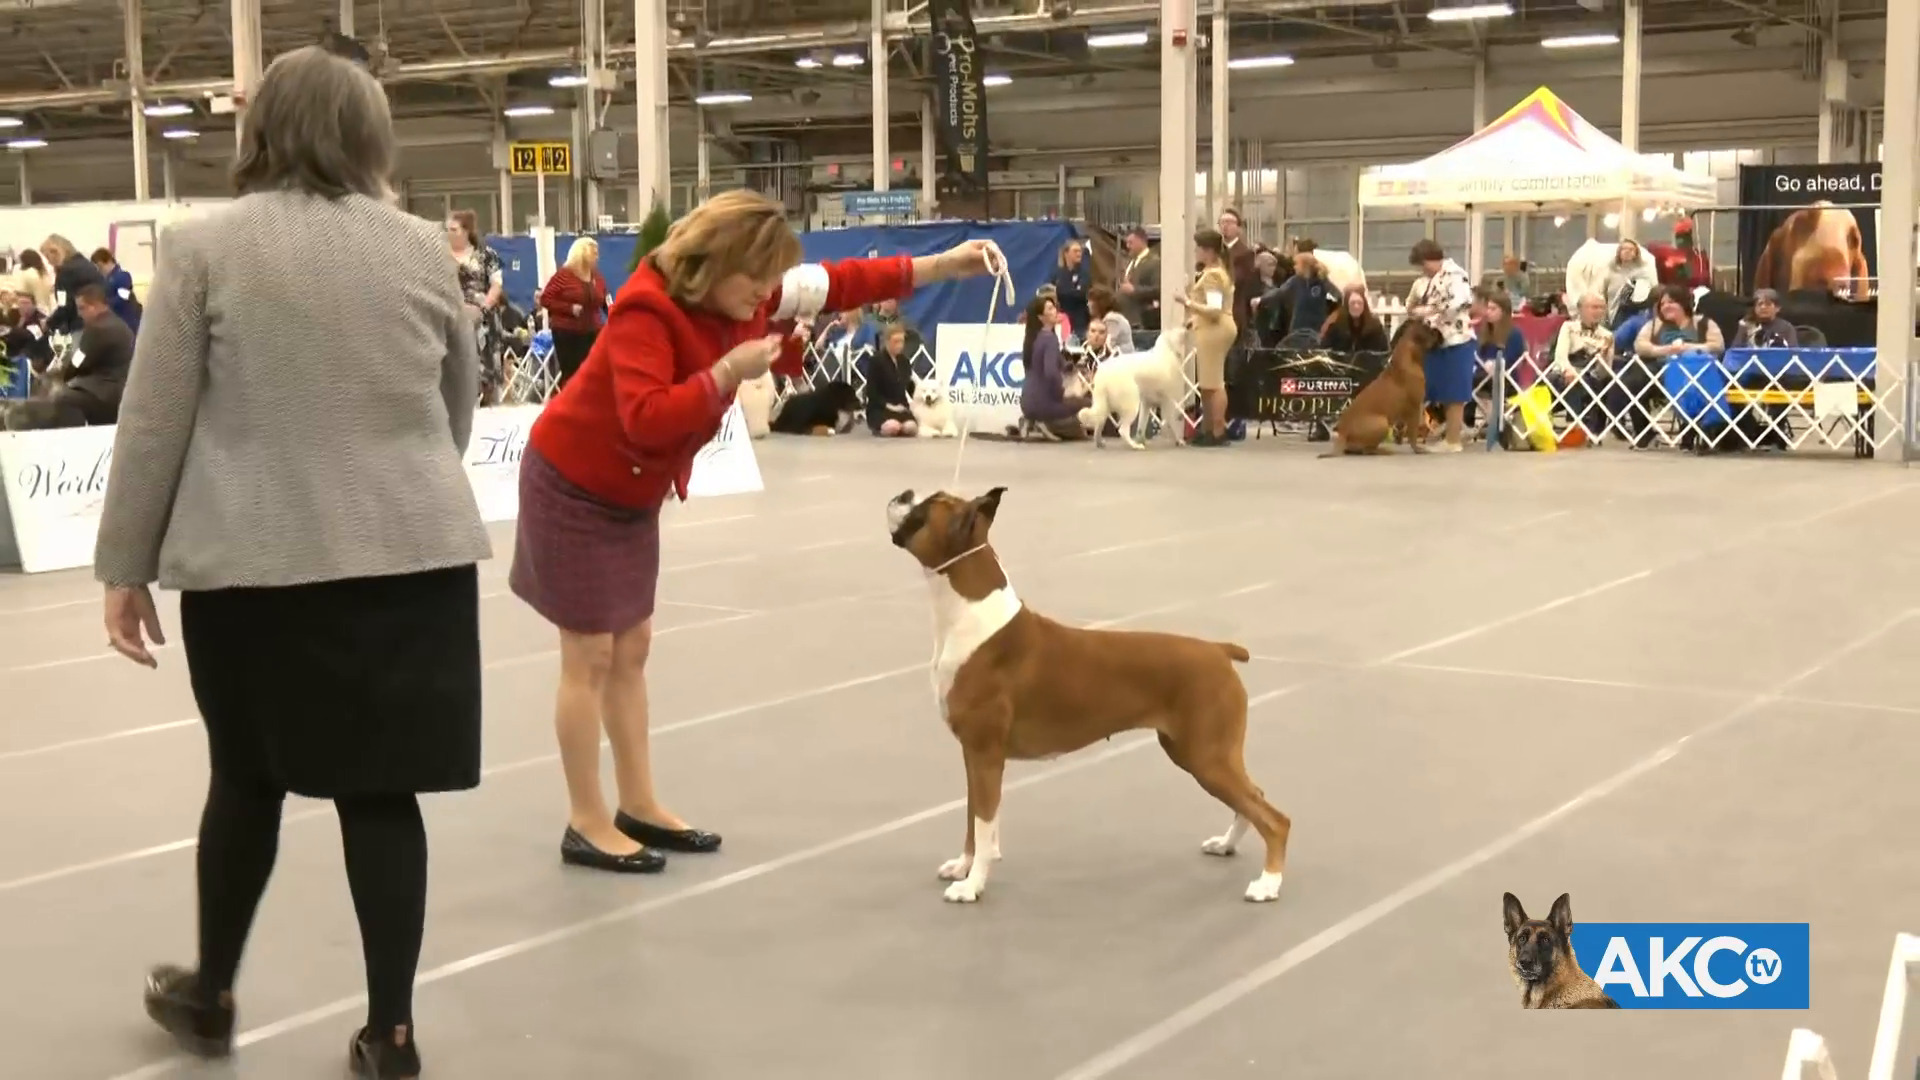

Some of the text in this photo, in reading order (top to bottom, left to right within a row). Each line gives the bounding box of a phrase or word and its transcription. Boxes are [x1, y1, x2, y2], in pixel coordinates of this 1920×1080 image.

[958, 34, 980, 139] Pro-Mohs
[949, 76, 959, 127] Products
[517, 149, 534, 170] 12
[1511, 173, 1608, 191] comfortable
[1775, 173, 1883, 192] Go ahead, D
[949, 351, 1025, 388] AKC
[1297, 380, 1349, 391] PURINA
[1257, 396, 1353, 415] PRO PLA
[472, 425, 525, 467] Thi
[18, 446, 113, 499] Work
